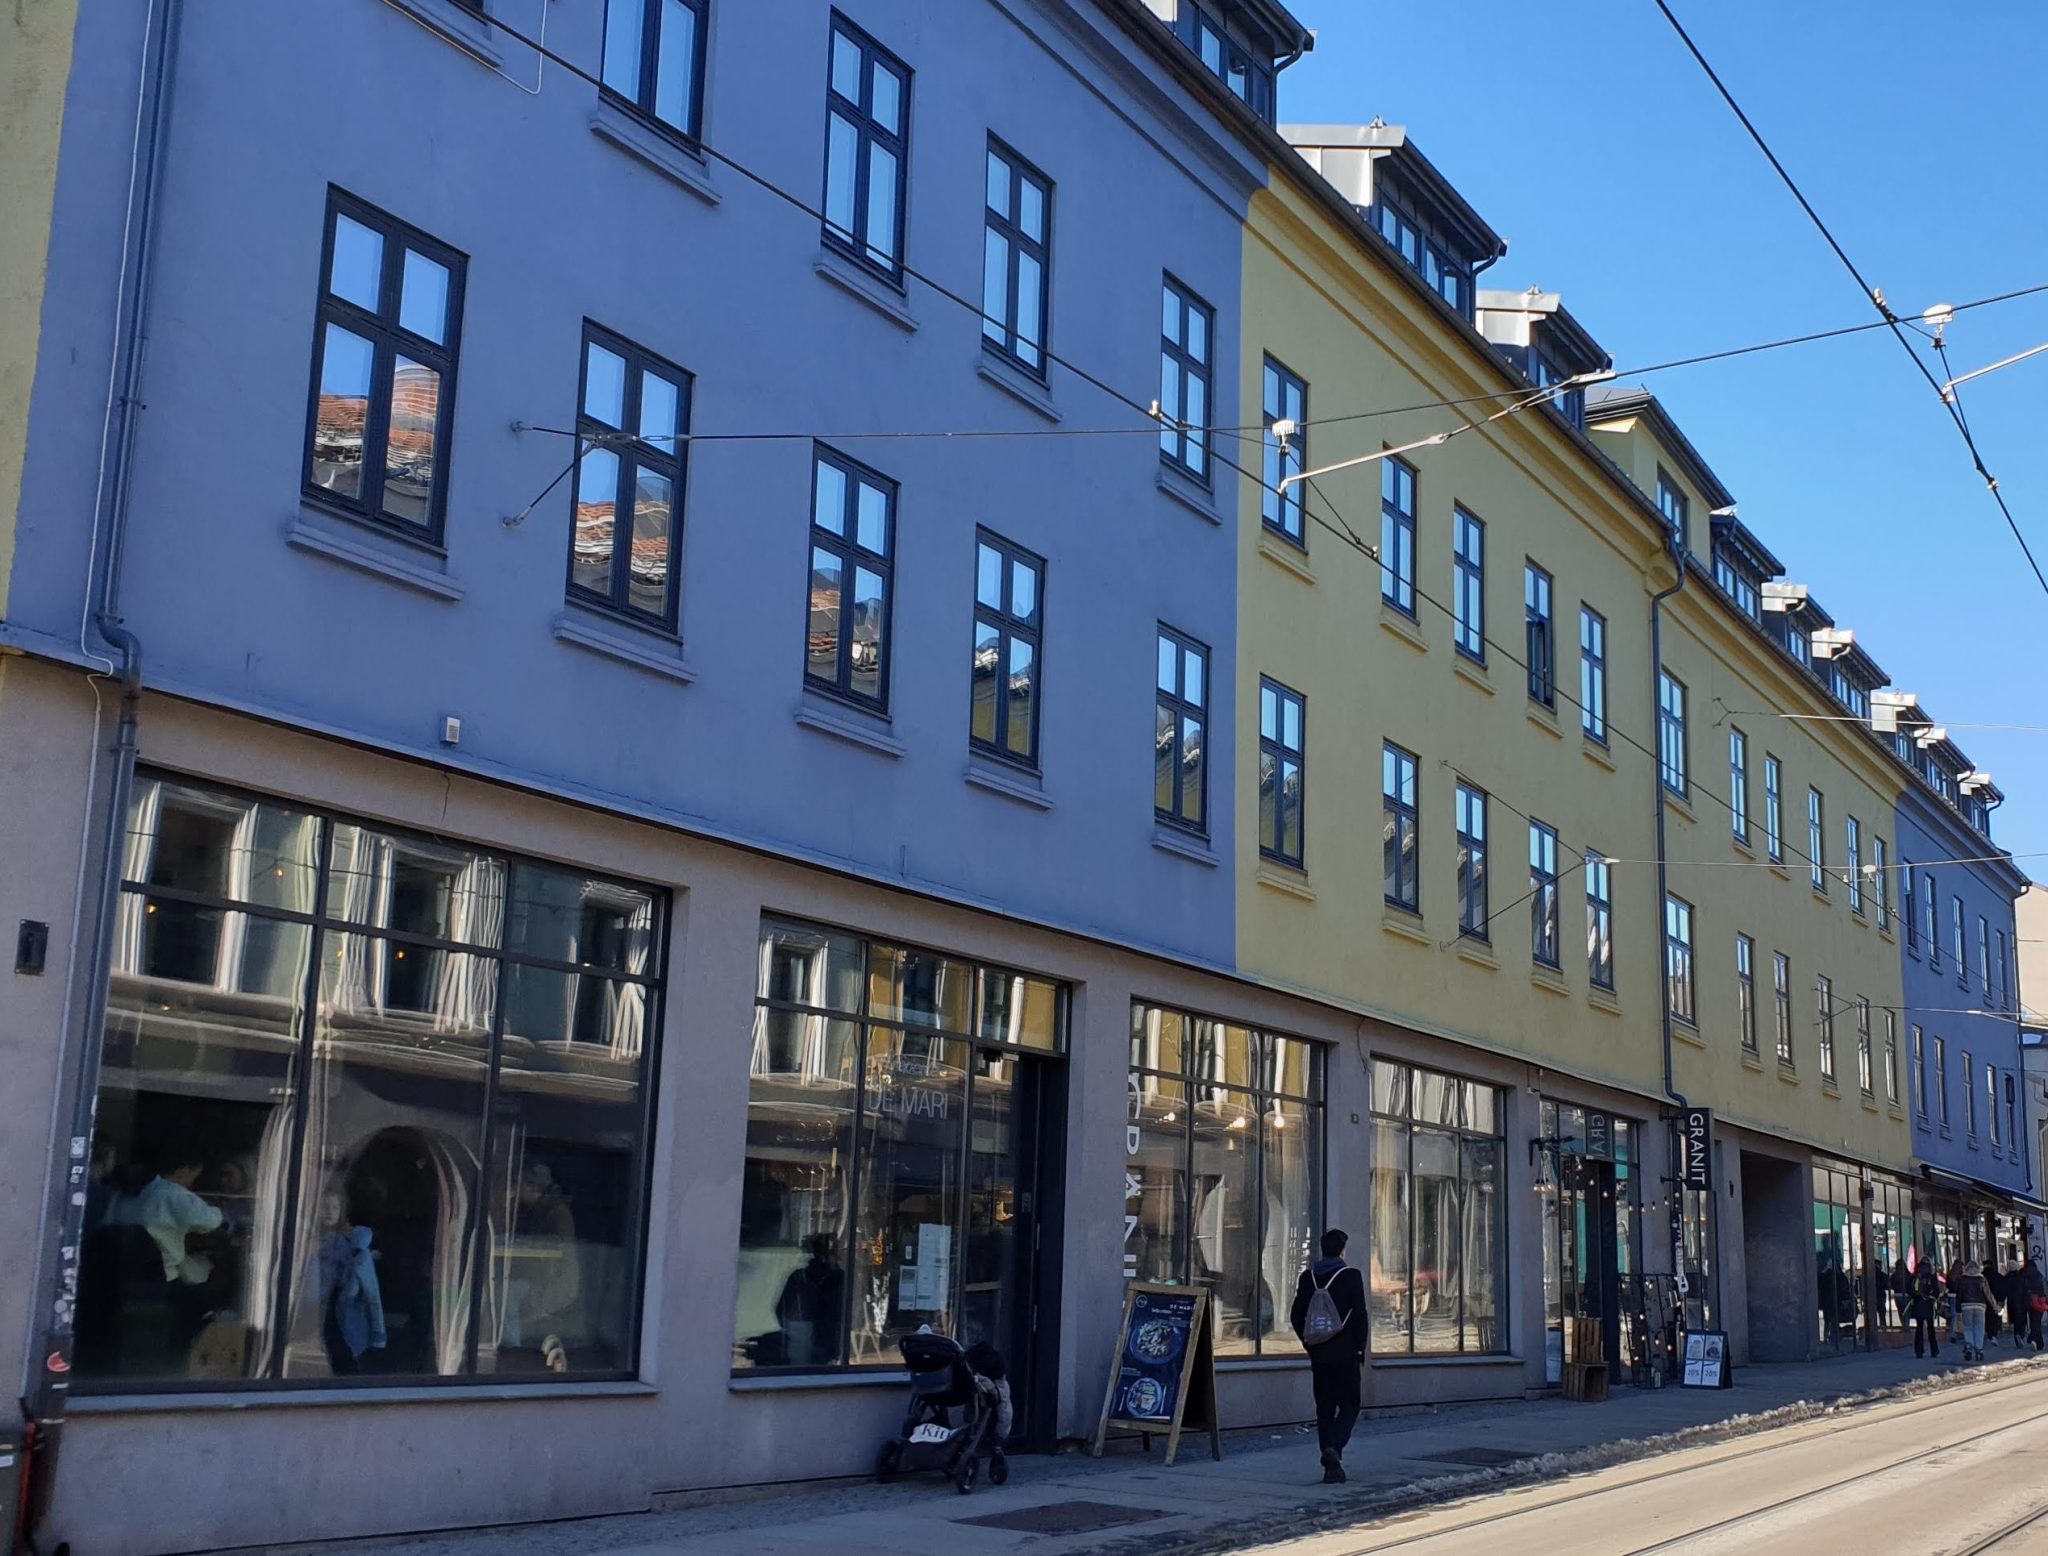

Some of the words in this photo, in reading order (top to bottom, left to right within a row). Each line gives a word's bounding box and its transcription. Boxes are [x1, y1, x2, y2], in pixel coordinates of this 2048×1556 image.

[868, 1084, 895, 1112] DE
[900, 1086, 949, 1119] MARI
[1689, 1112, 1706, 1185] GRANIT
